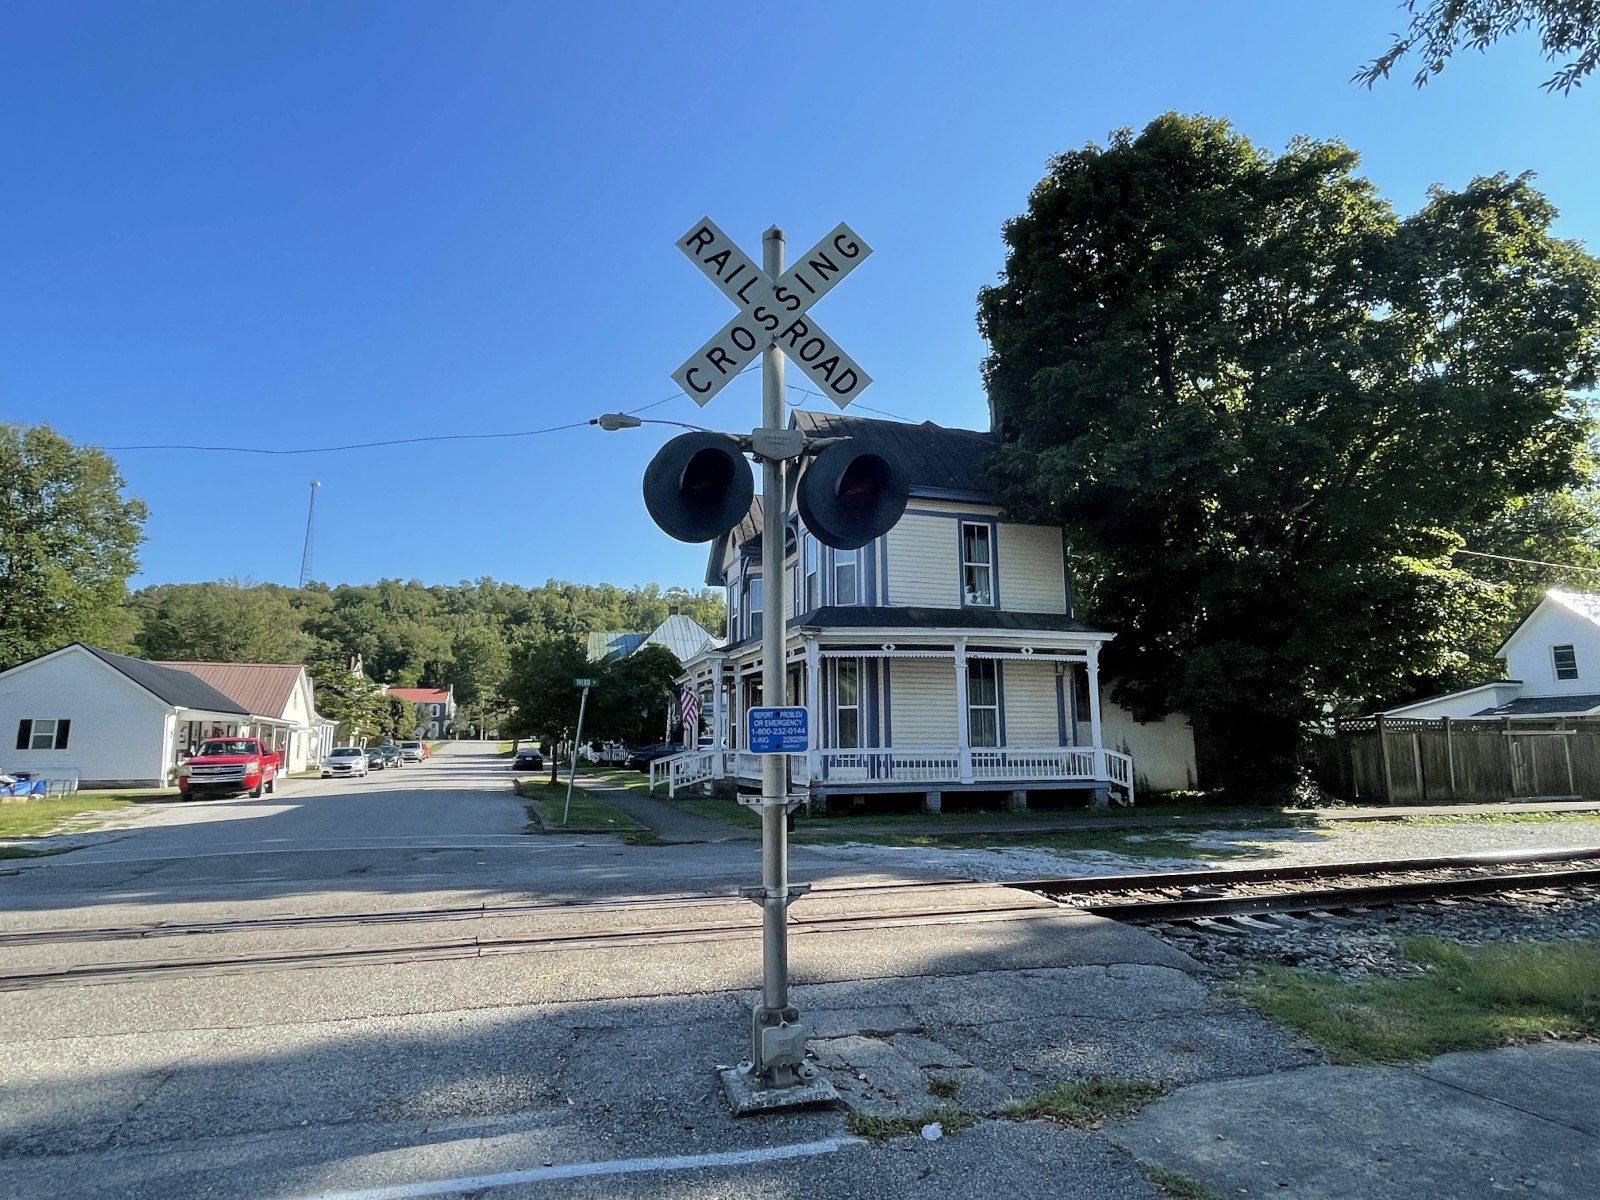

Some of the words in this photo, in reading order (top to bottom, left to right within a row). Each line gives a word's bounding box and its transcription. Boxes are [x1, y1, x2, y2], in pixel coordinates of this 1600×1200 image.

[686, 234, 860, 393] CROSSING
[765, 719, 803, 727] EMERGENCY
[751, 727, 806, 736] 1-800-232-0144
[752, 736, 770, 744] X-ING
